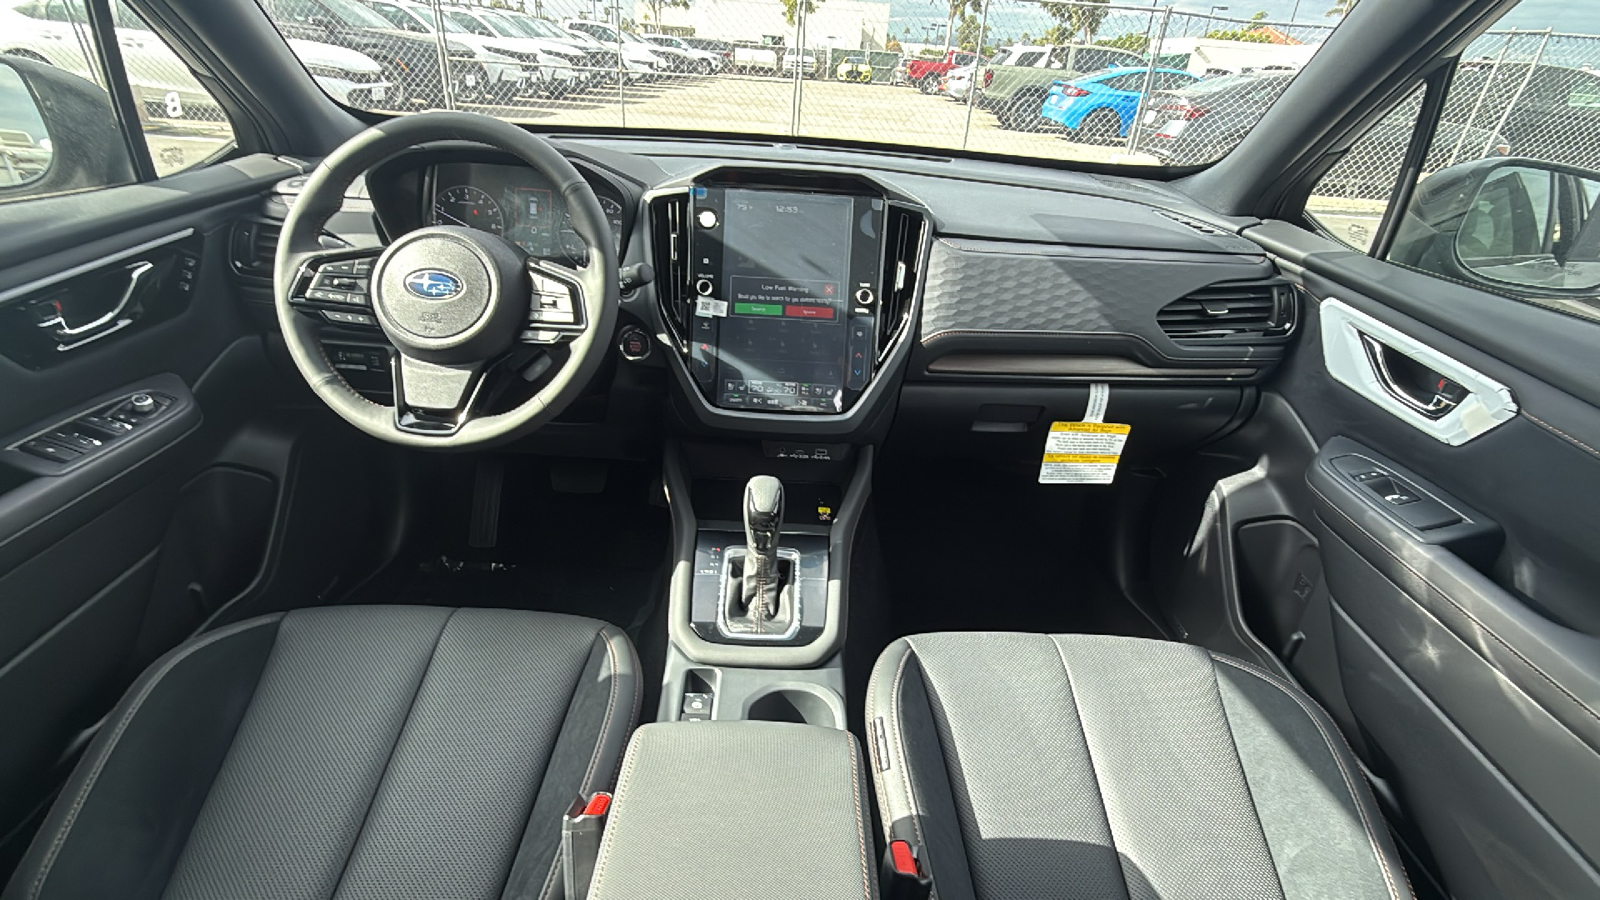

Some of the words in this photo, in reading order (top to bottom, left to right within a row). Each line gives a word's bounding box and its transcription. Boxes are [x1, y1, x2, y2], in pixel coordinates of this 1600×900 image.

[775, 205, 798, 214] 12:53
[788, 286, 809, 294] Warning
[783, 386, 795, 394] 70
